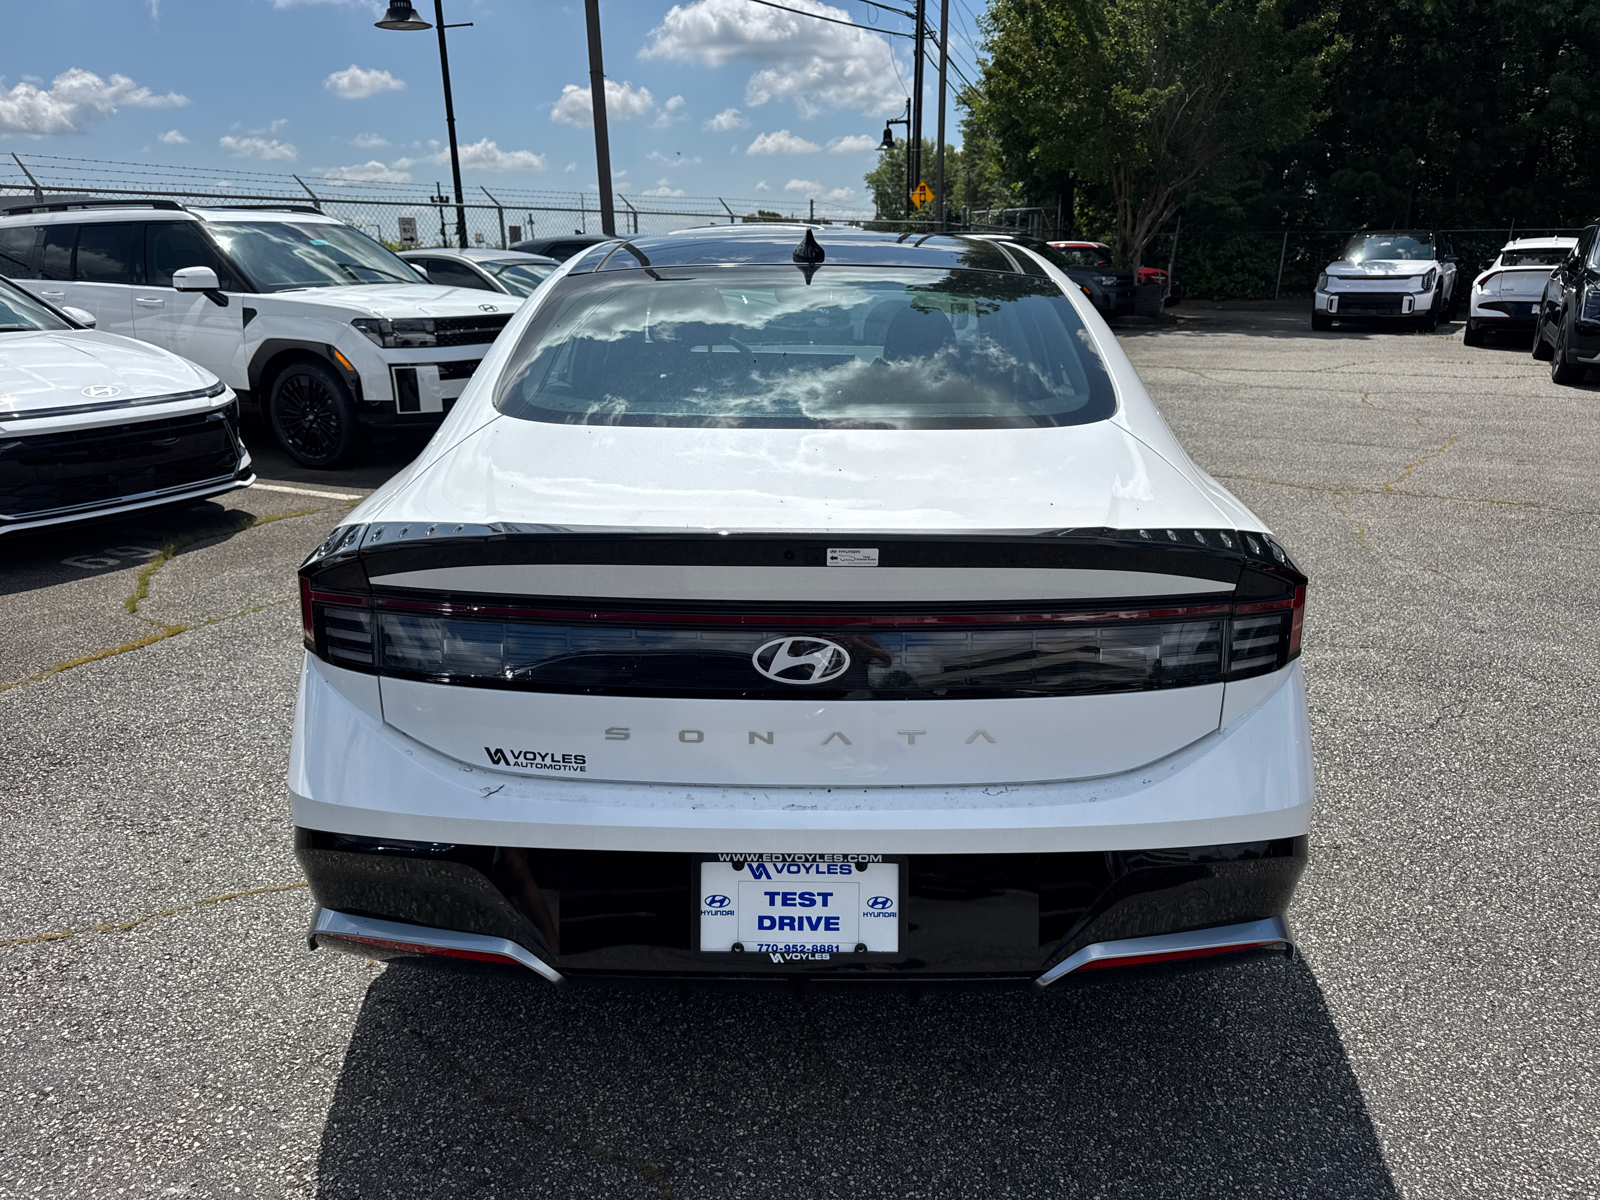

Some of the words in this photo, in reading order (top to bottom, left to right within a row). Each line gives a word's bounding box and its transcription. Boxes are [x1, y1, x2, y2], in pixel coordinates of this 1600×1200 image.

[604, 726, 997, 746] SONATA
[510, 749, 586, 765] VOYLES
[512, 761, 587, 773] AUTOMOTIVE
[718, 853, 882, 863] WWW.EDVOYLES.COM
[773, 863, 852, 875] VOYLES
[764, 891, 834, 908] TEST
[757, 915, 840, 931] DRIVE
[757, 943, 840, 953] 770-952-8881
